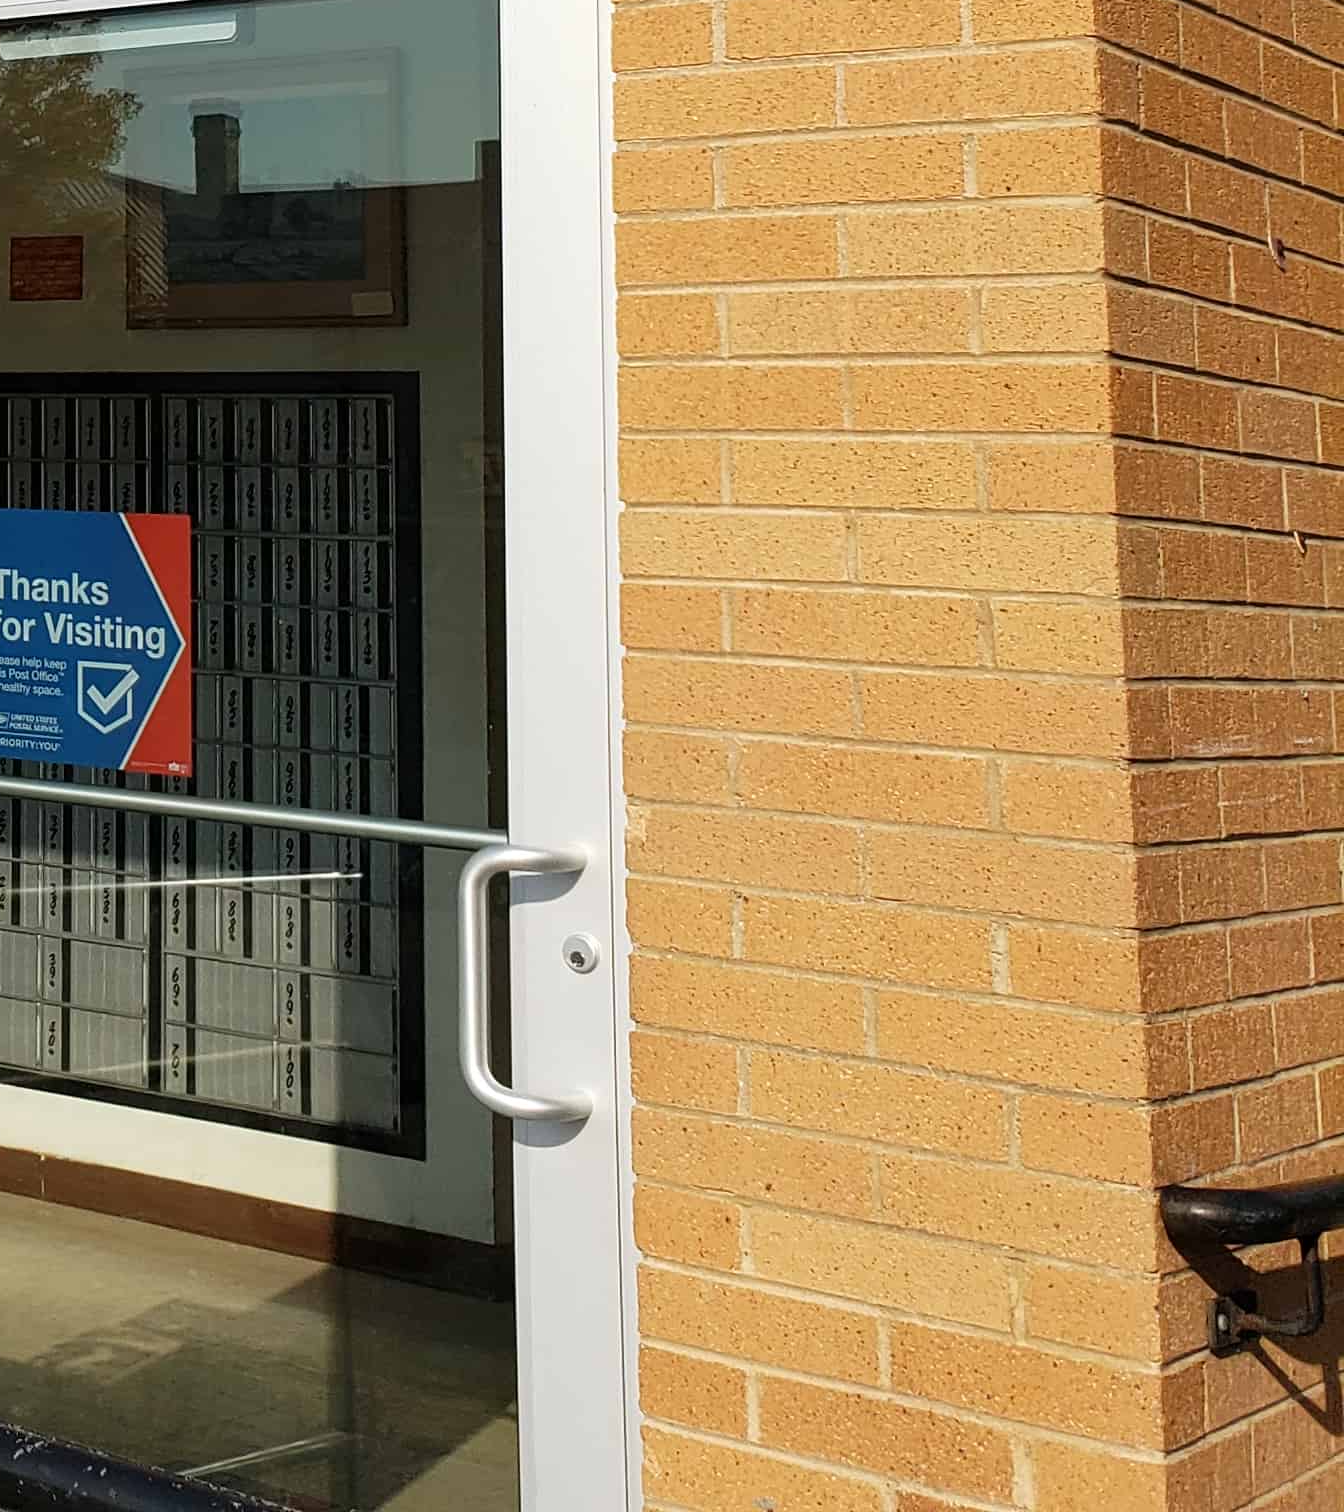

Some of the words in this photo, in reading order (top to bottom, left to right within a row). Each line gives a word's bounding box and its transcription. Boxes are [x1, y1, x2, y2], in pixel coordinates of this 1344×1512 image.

[44, 611, 165, 659] Visiting
[22, 656, 42, 670] help
[44, 657, 67, 672] keep
[8, 668, 29, 681] Post
